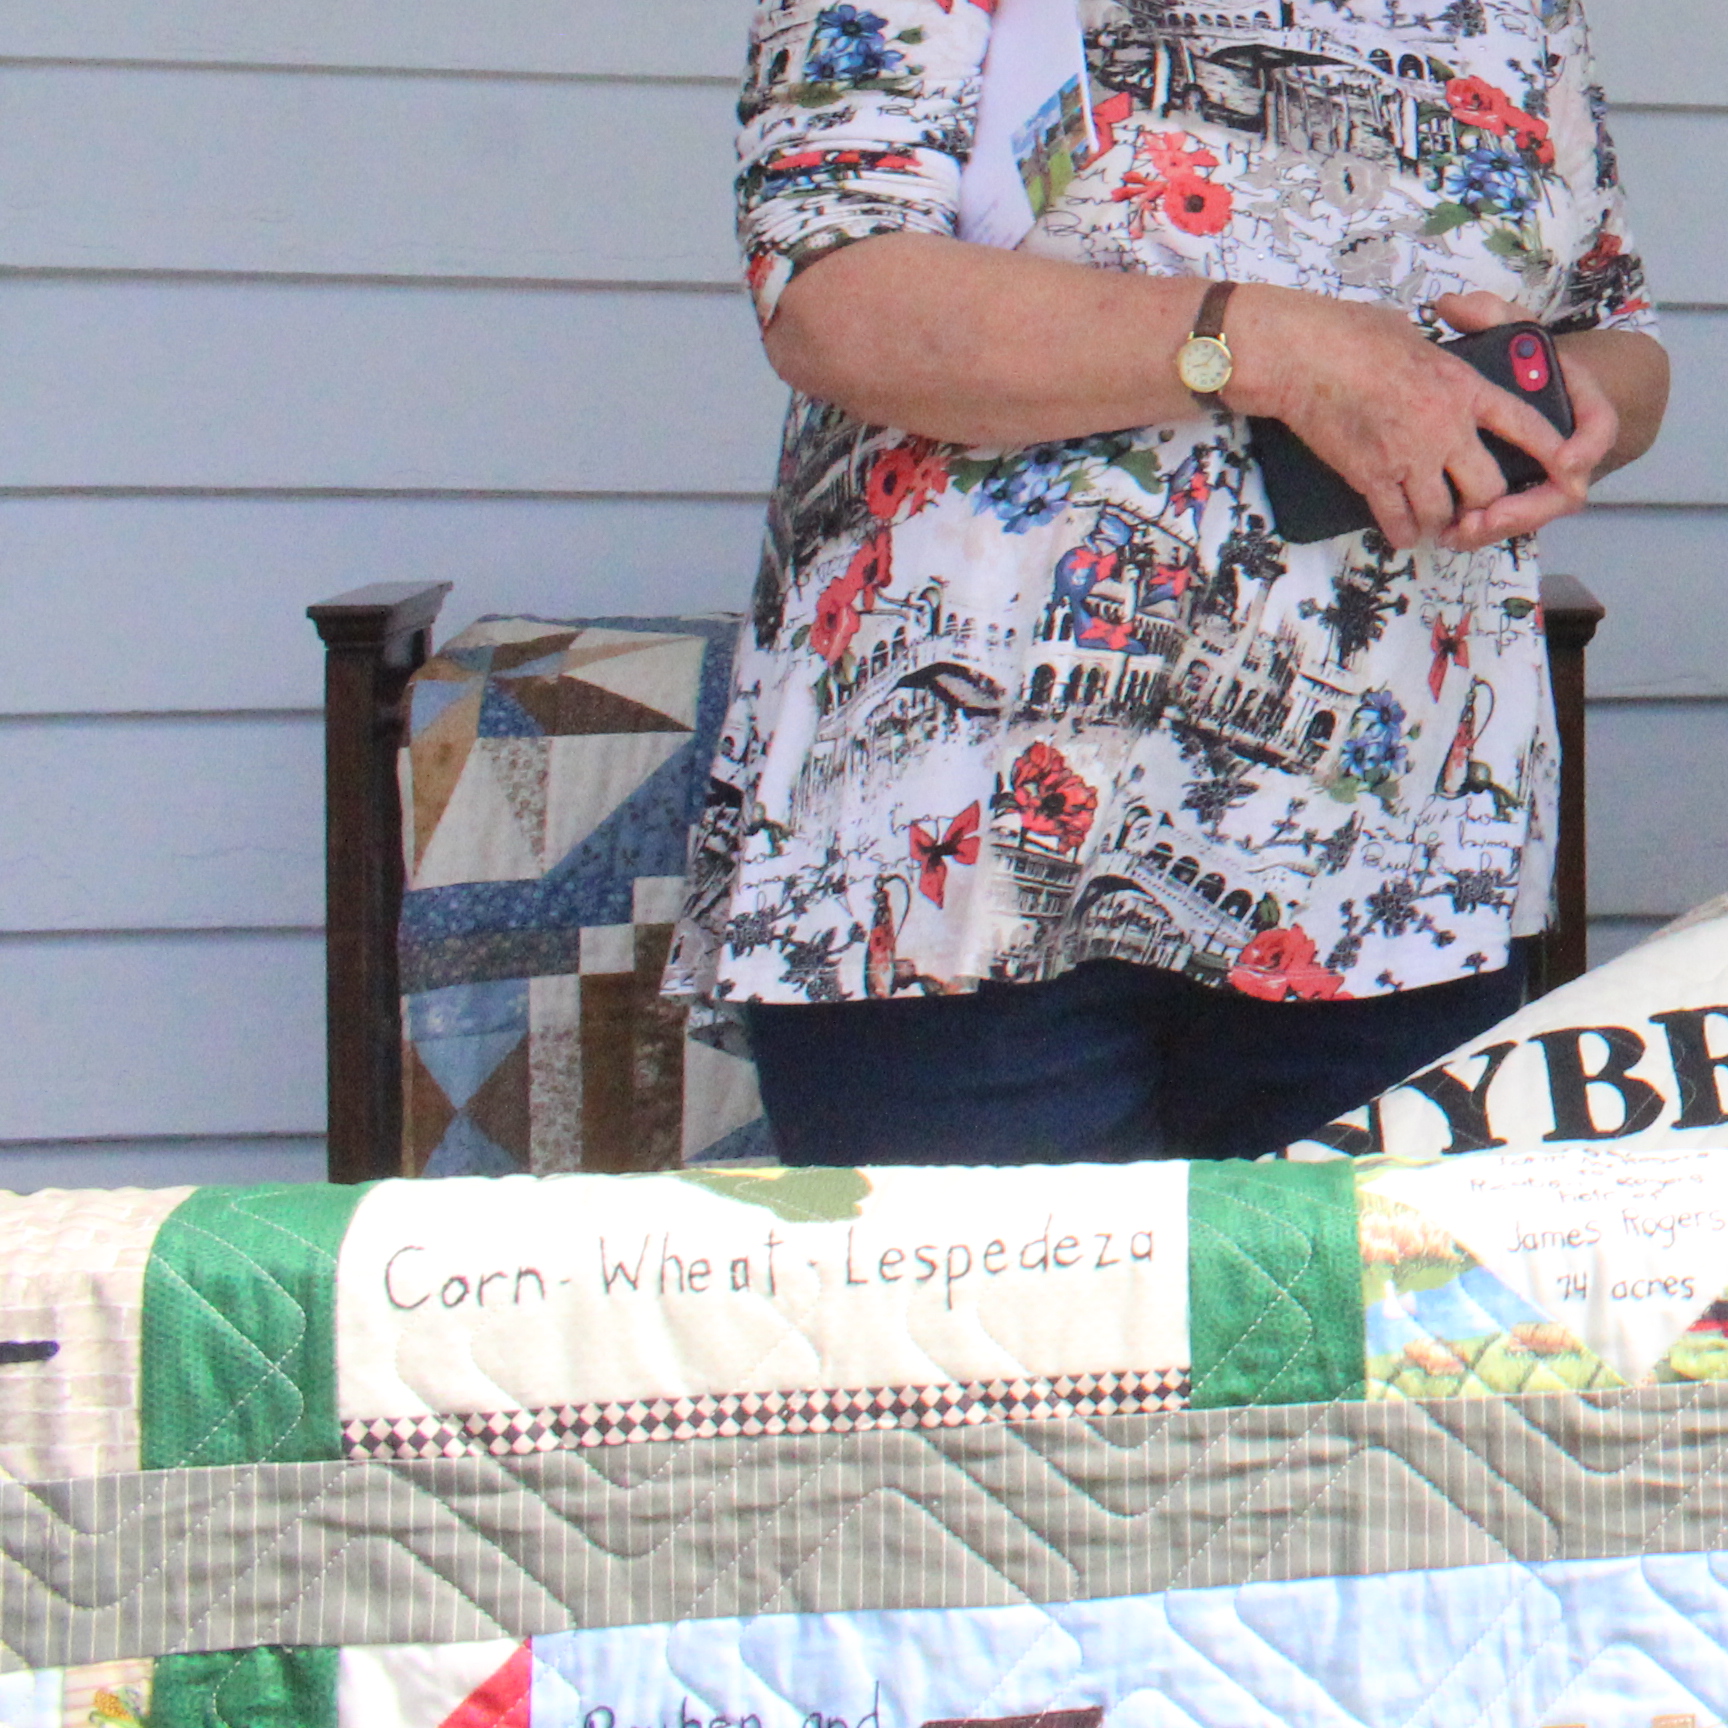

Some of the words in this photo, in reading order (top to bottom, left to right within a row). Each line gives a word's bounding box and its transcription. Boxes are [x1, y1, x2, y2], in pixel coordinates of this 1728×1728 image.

[1507, 1219, 1602, 1254] James
[1621, 1207, 1727, 1250] Rogers
[844, 1214, 1157, 1311] Lespedeza
[1556, 1270, 1588, 1302] 74
[1610, 1273, 1697, 1302] acres
